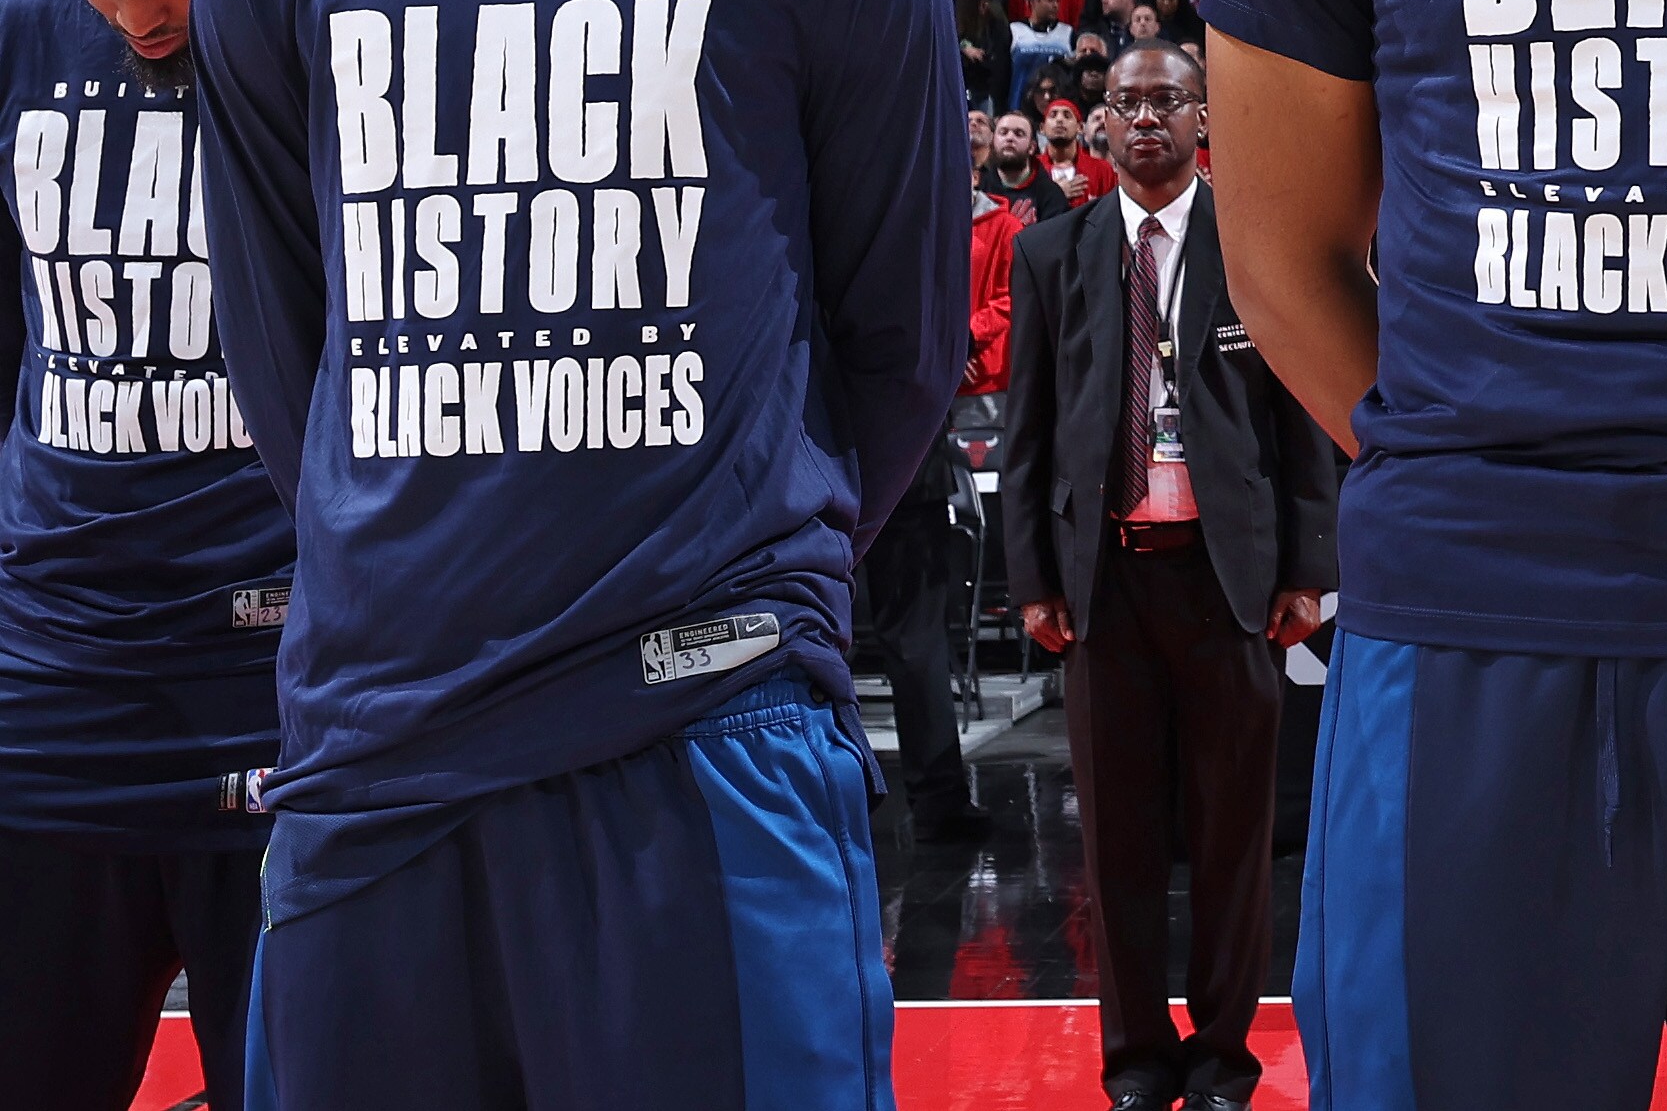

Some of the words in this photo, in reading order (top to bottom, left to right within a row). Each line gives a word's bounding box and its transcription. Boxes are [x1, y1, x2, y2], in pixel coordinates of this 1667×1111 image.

[342, 186, 706, 322] HISTORY
[350, 327, 591, 356] ELEVATED
[641, 322, 696, 344] BY
[37, 370, 147, 454] BLACK
[350, 361, 505, 459] BLACK
[512, 350, 705, 453] VOICES
[260, 606, 282, 623] 23
[678, 623, 729, 639] ENGINEERED
[678, 647, 712, 670] 33
